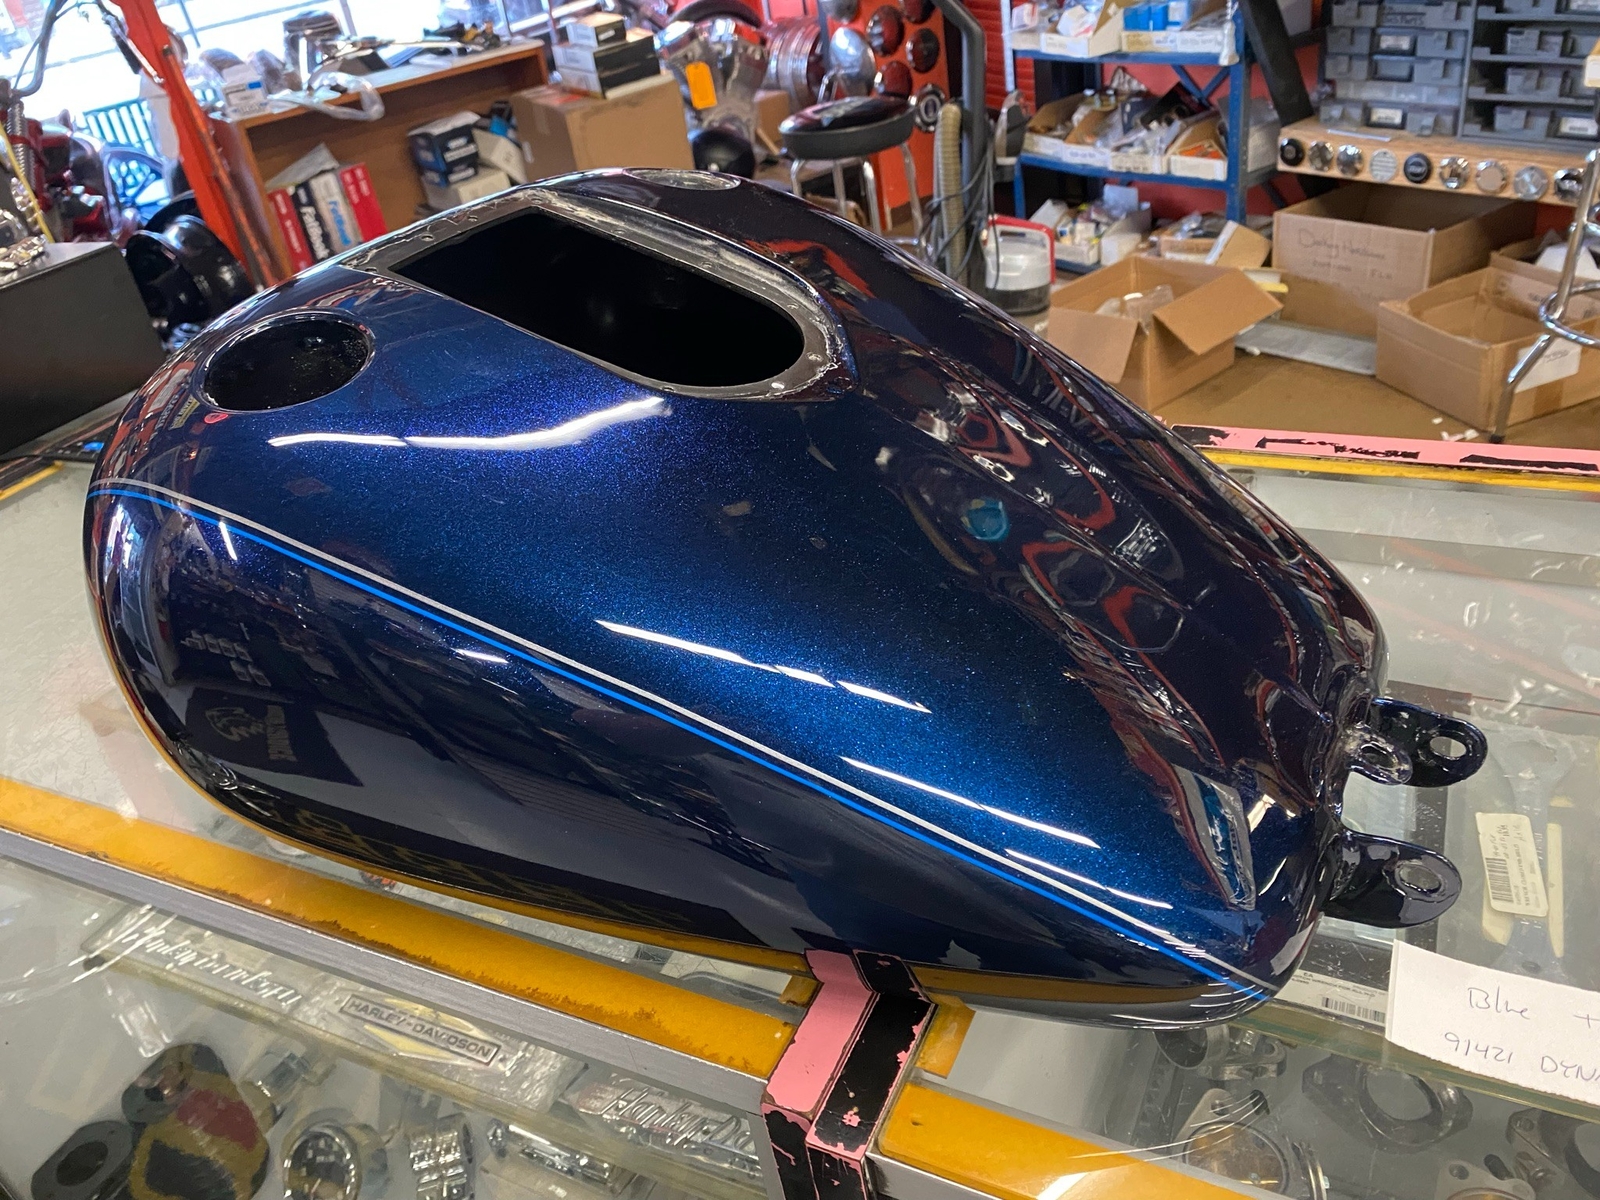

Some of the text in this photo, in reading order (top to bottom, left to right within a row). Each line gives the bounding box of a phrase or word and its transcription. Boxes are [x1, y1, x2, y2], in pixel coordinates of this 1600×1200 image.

[1467, 985, 1531, 1020] Blue
[350, 999, 491, 1058] HARLEY-DAVIDSON
[1444, 1031, 1514, 1064] 91421
